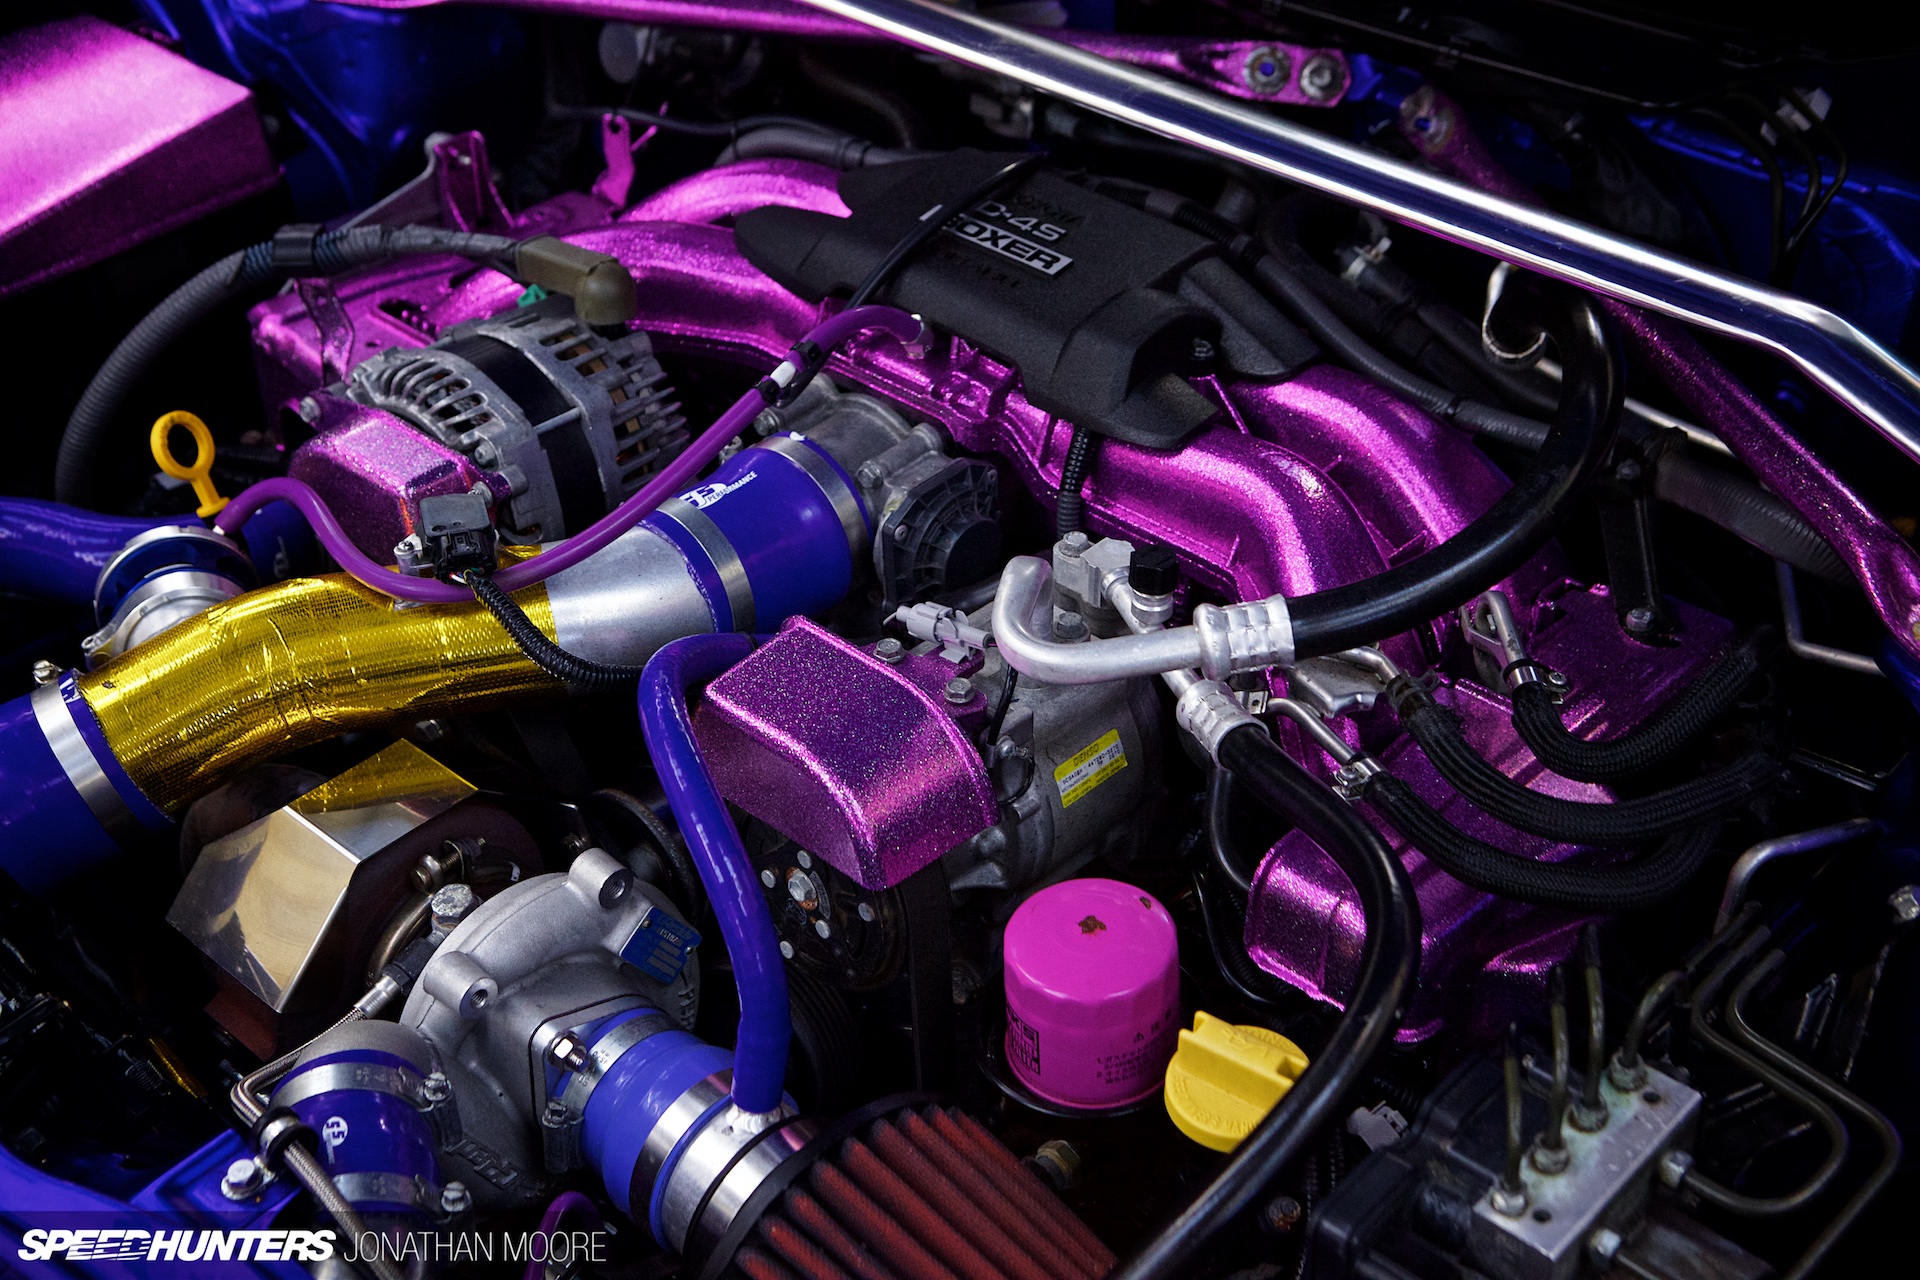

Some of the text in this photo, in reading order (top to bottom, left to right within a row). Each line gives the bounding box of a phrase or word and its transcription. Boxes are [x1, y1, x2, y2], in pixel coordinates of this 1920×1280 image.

[947, 216, 1062, 271] OXER
[707, 470, 758, 502] PERFORMANCE
[1072, 742, 1100, 767] DENSO
